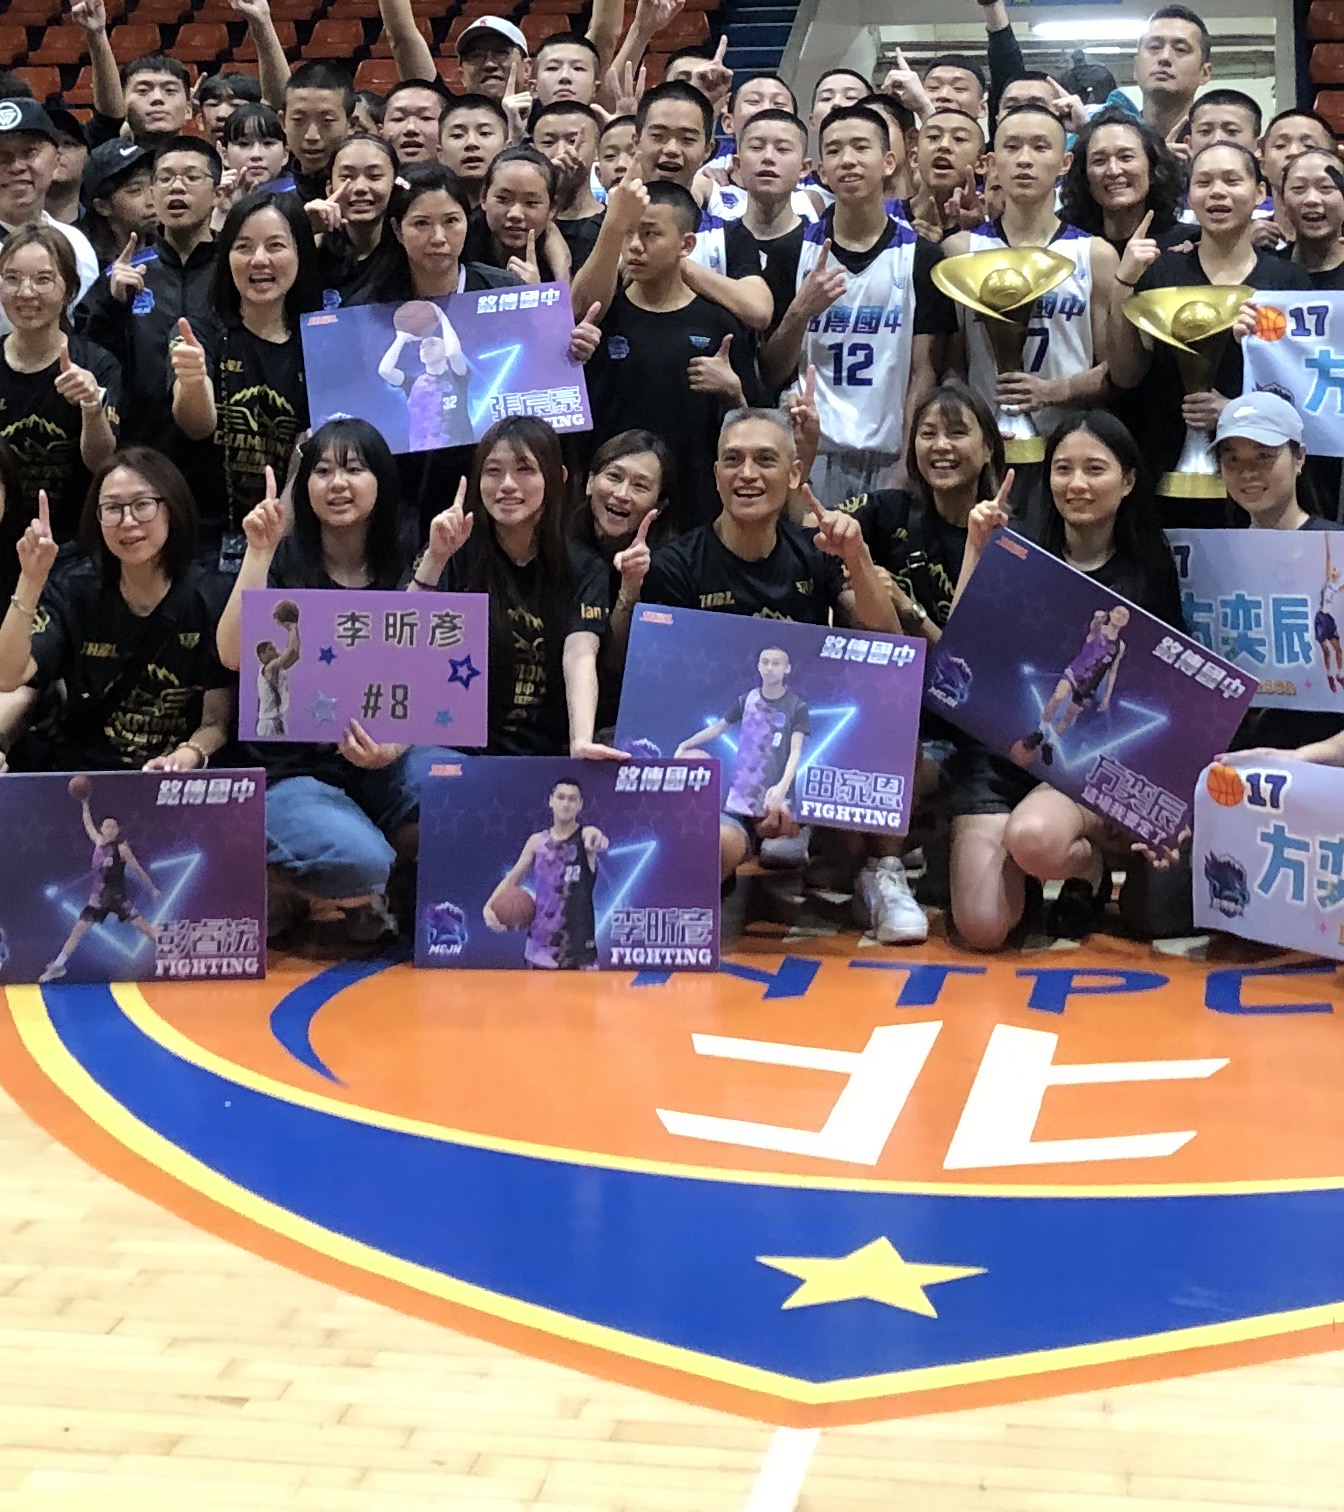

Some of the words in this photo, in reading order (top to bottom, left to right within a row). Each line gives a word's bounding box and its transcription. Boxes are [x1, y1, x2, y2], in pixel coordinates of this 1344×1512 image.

[1288, 304, 1330, 338] 17
[828, 342, 876, 387] 12
[1173, 544, 1192, 578] 7
[820, 635, 917, 669] 銘傳國中
[360, 682, 410, 721] #8
[155, 777, 256, 807] 銘傳國中
[614, 765, 712, 793] 銘傳國中
[1245, 772, 1289, 809] 17
[801, 800, 902, 829] FIGHTING
[155, 956, 260, 977] FIGHTING
[609, 947, 713, 966] FIGHTING
